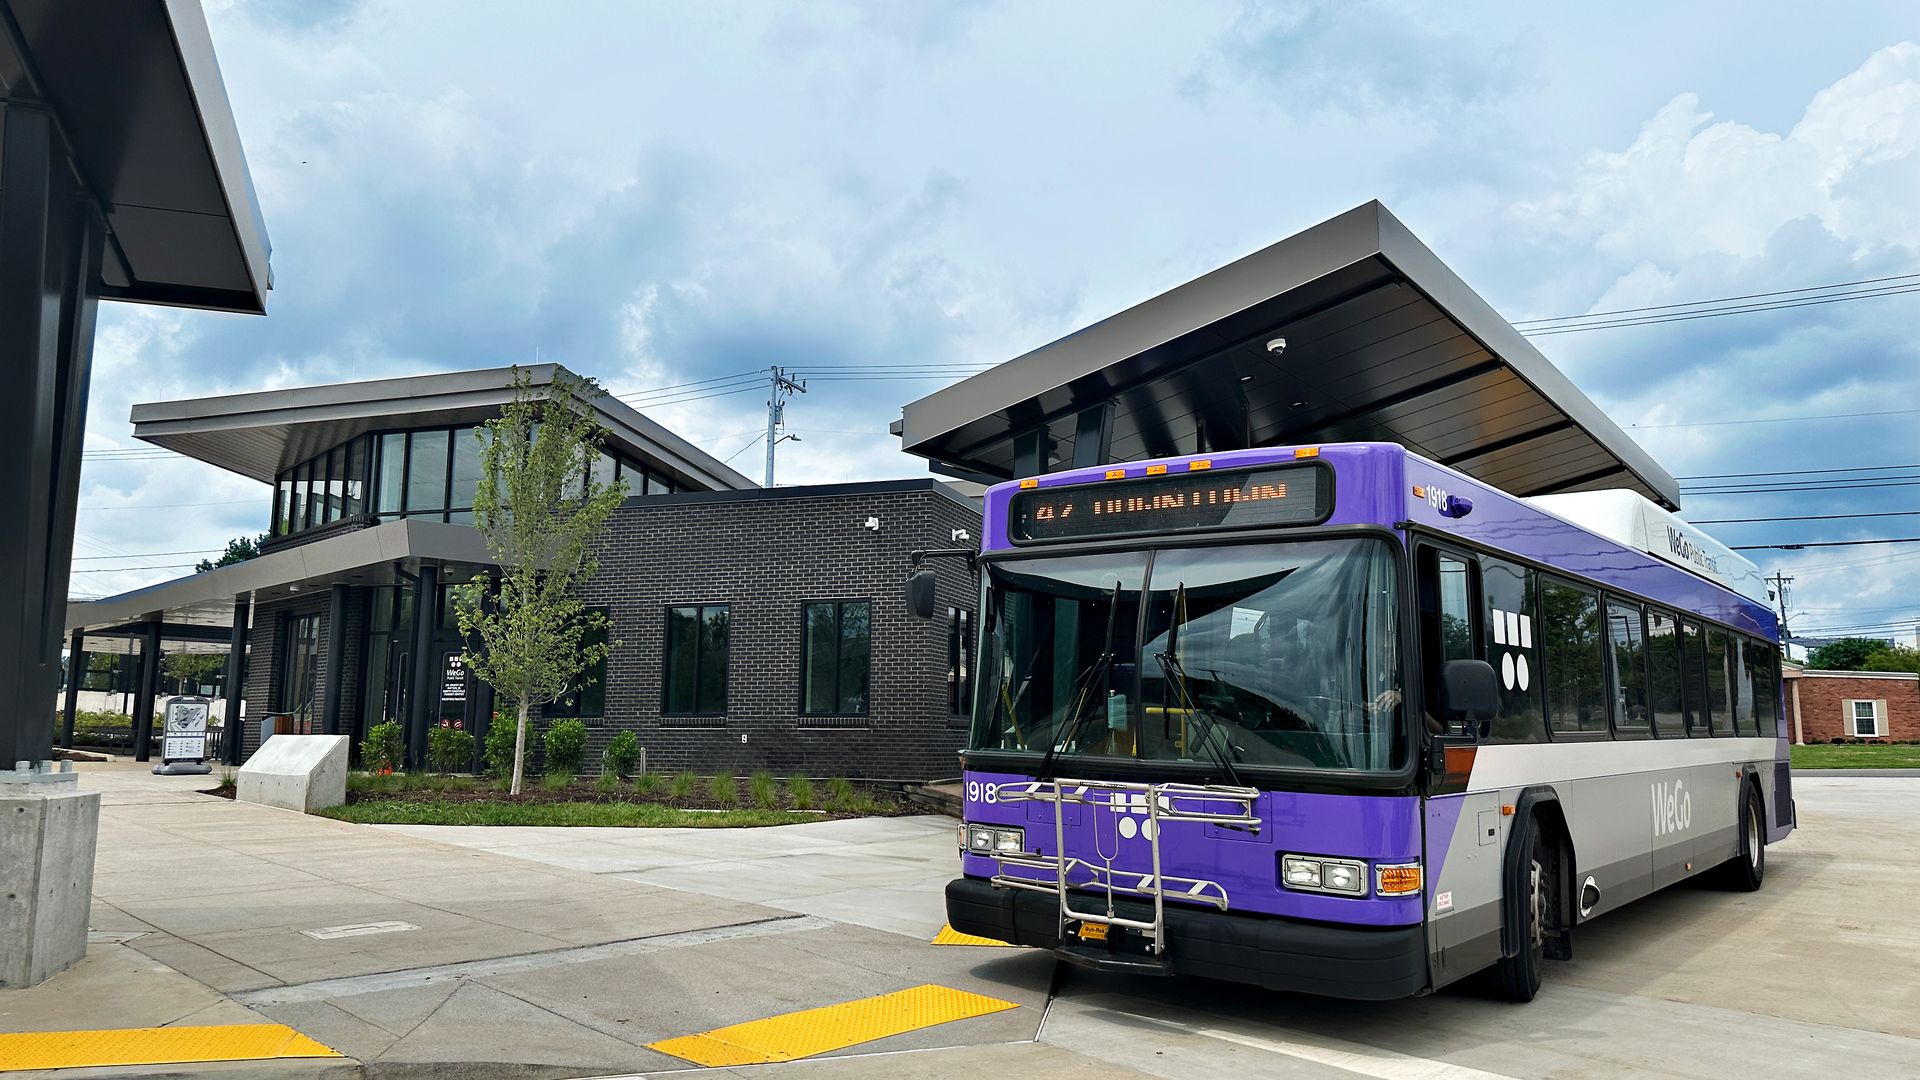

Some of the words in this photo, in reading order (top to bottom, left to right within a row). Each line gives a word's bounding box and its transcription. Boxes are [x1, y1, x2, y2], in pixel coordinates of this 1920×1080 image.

[1426, 484, 1448, 512] 1918
[1666, 524, 1690, 561] WeGo
[446, 669, 465, 677] WeGo
[965, 780, 998, 804] 1918
[1650, 778, 1691, 837] WeGo
